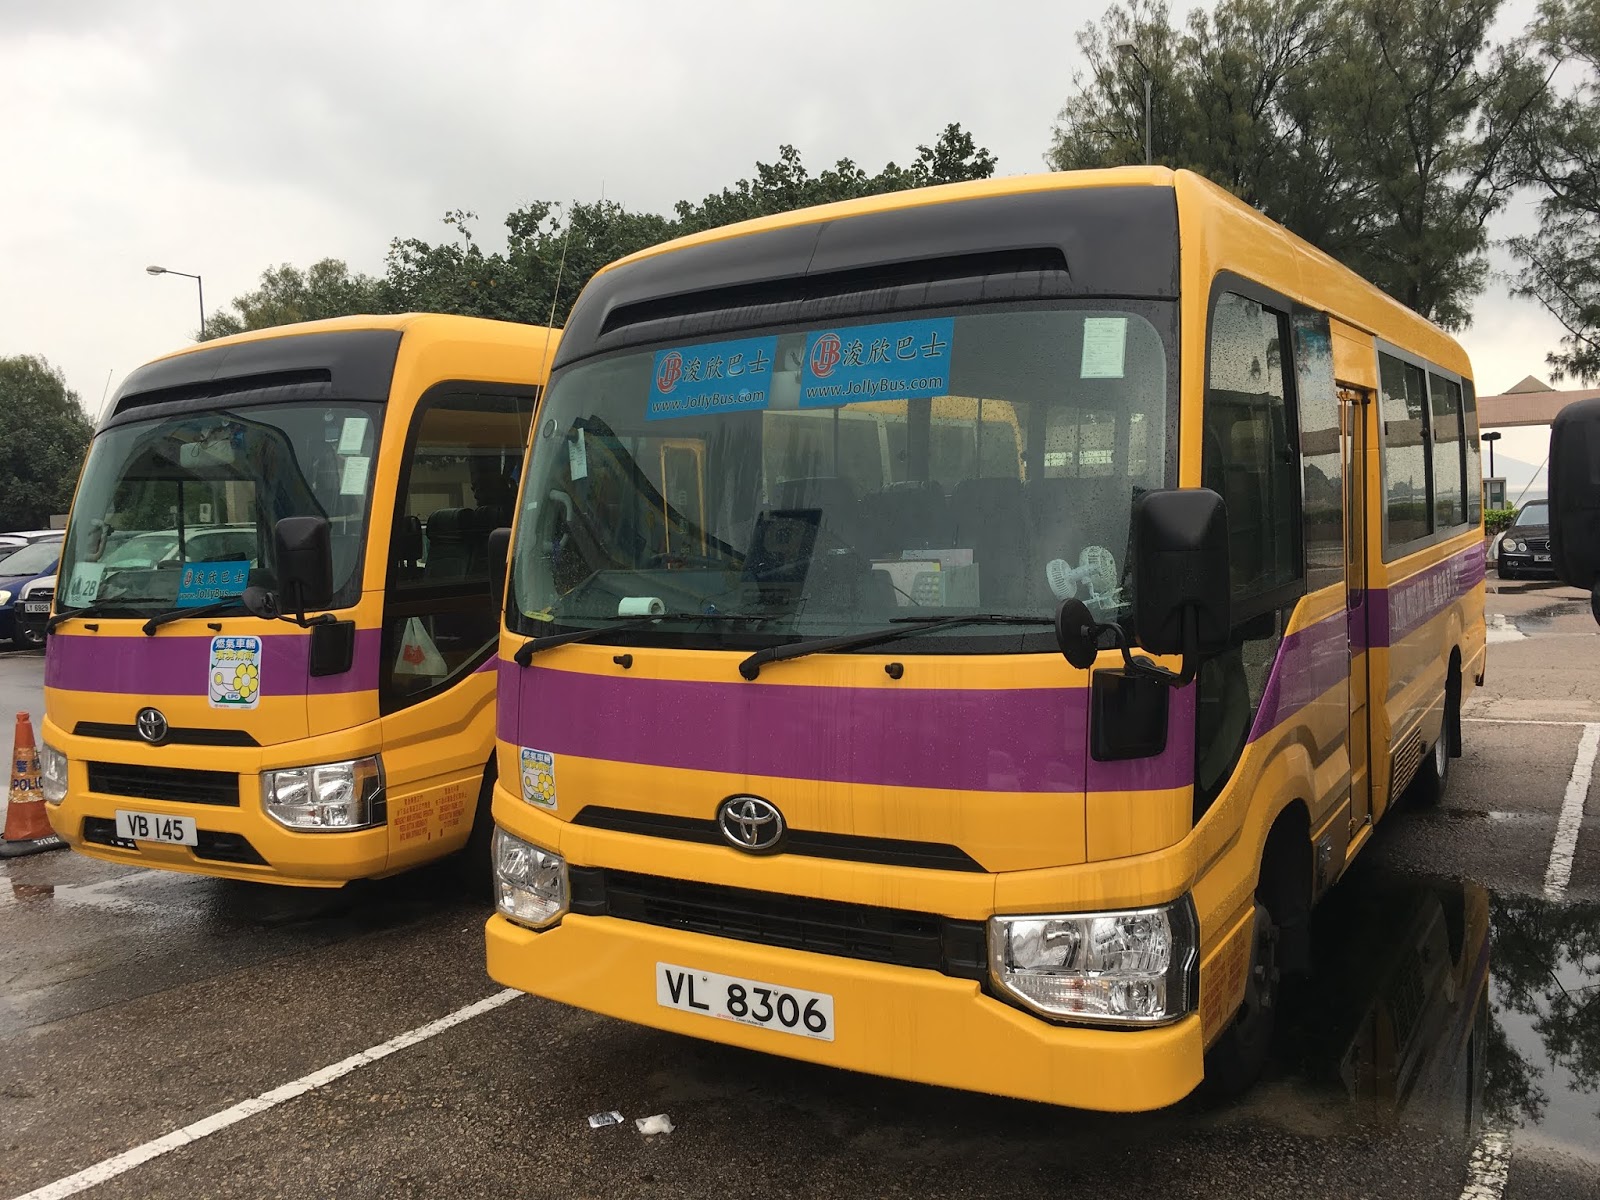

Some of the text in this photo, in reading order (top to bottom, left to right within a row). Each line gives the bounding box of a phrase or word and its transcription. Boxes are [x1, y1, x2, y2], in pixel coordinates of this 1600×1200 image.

[842, 331, 947, 367] 浚欣巴士
[683, 349, 770, 382] 浚欣巴士
[652, 390, 765, 413] www.JollyBus.com
[806, 376, 943, 398] www.JollyBus.com
[127, 814, 185, 841] VB 145
[665, 969, 827, 1033] VL 8306
